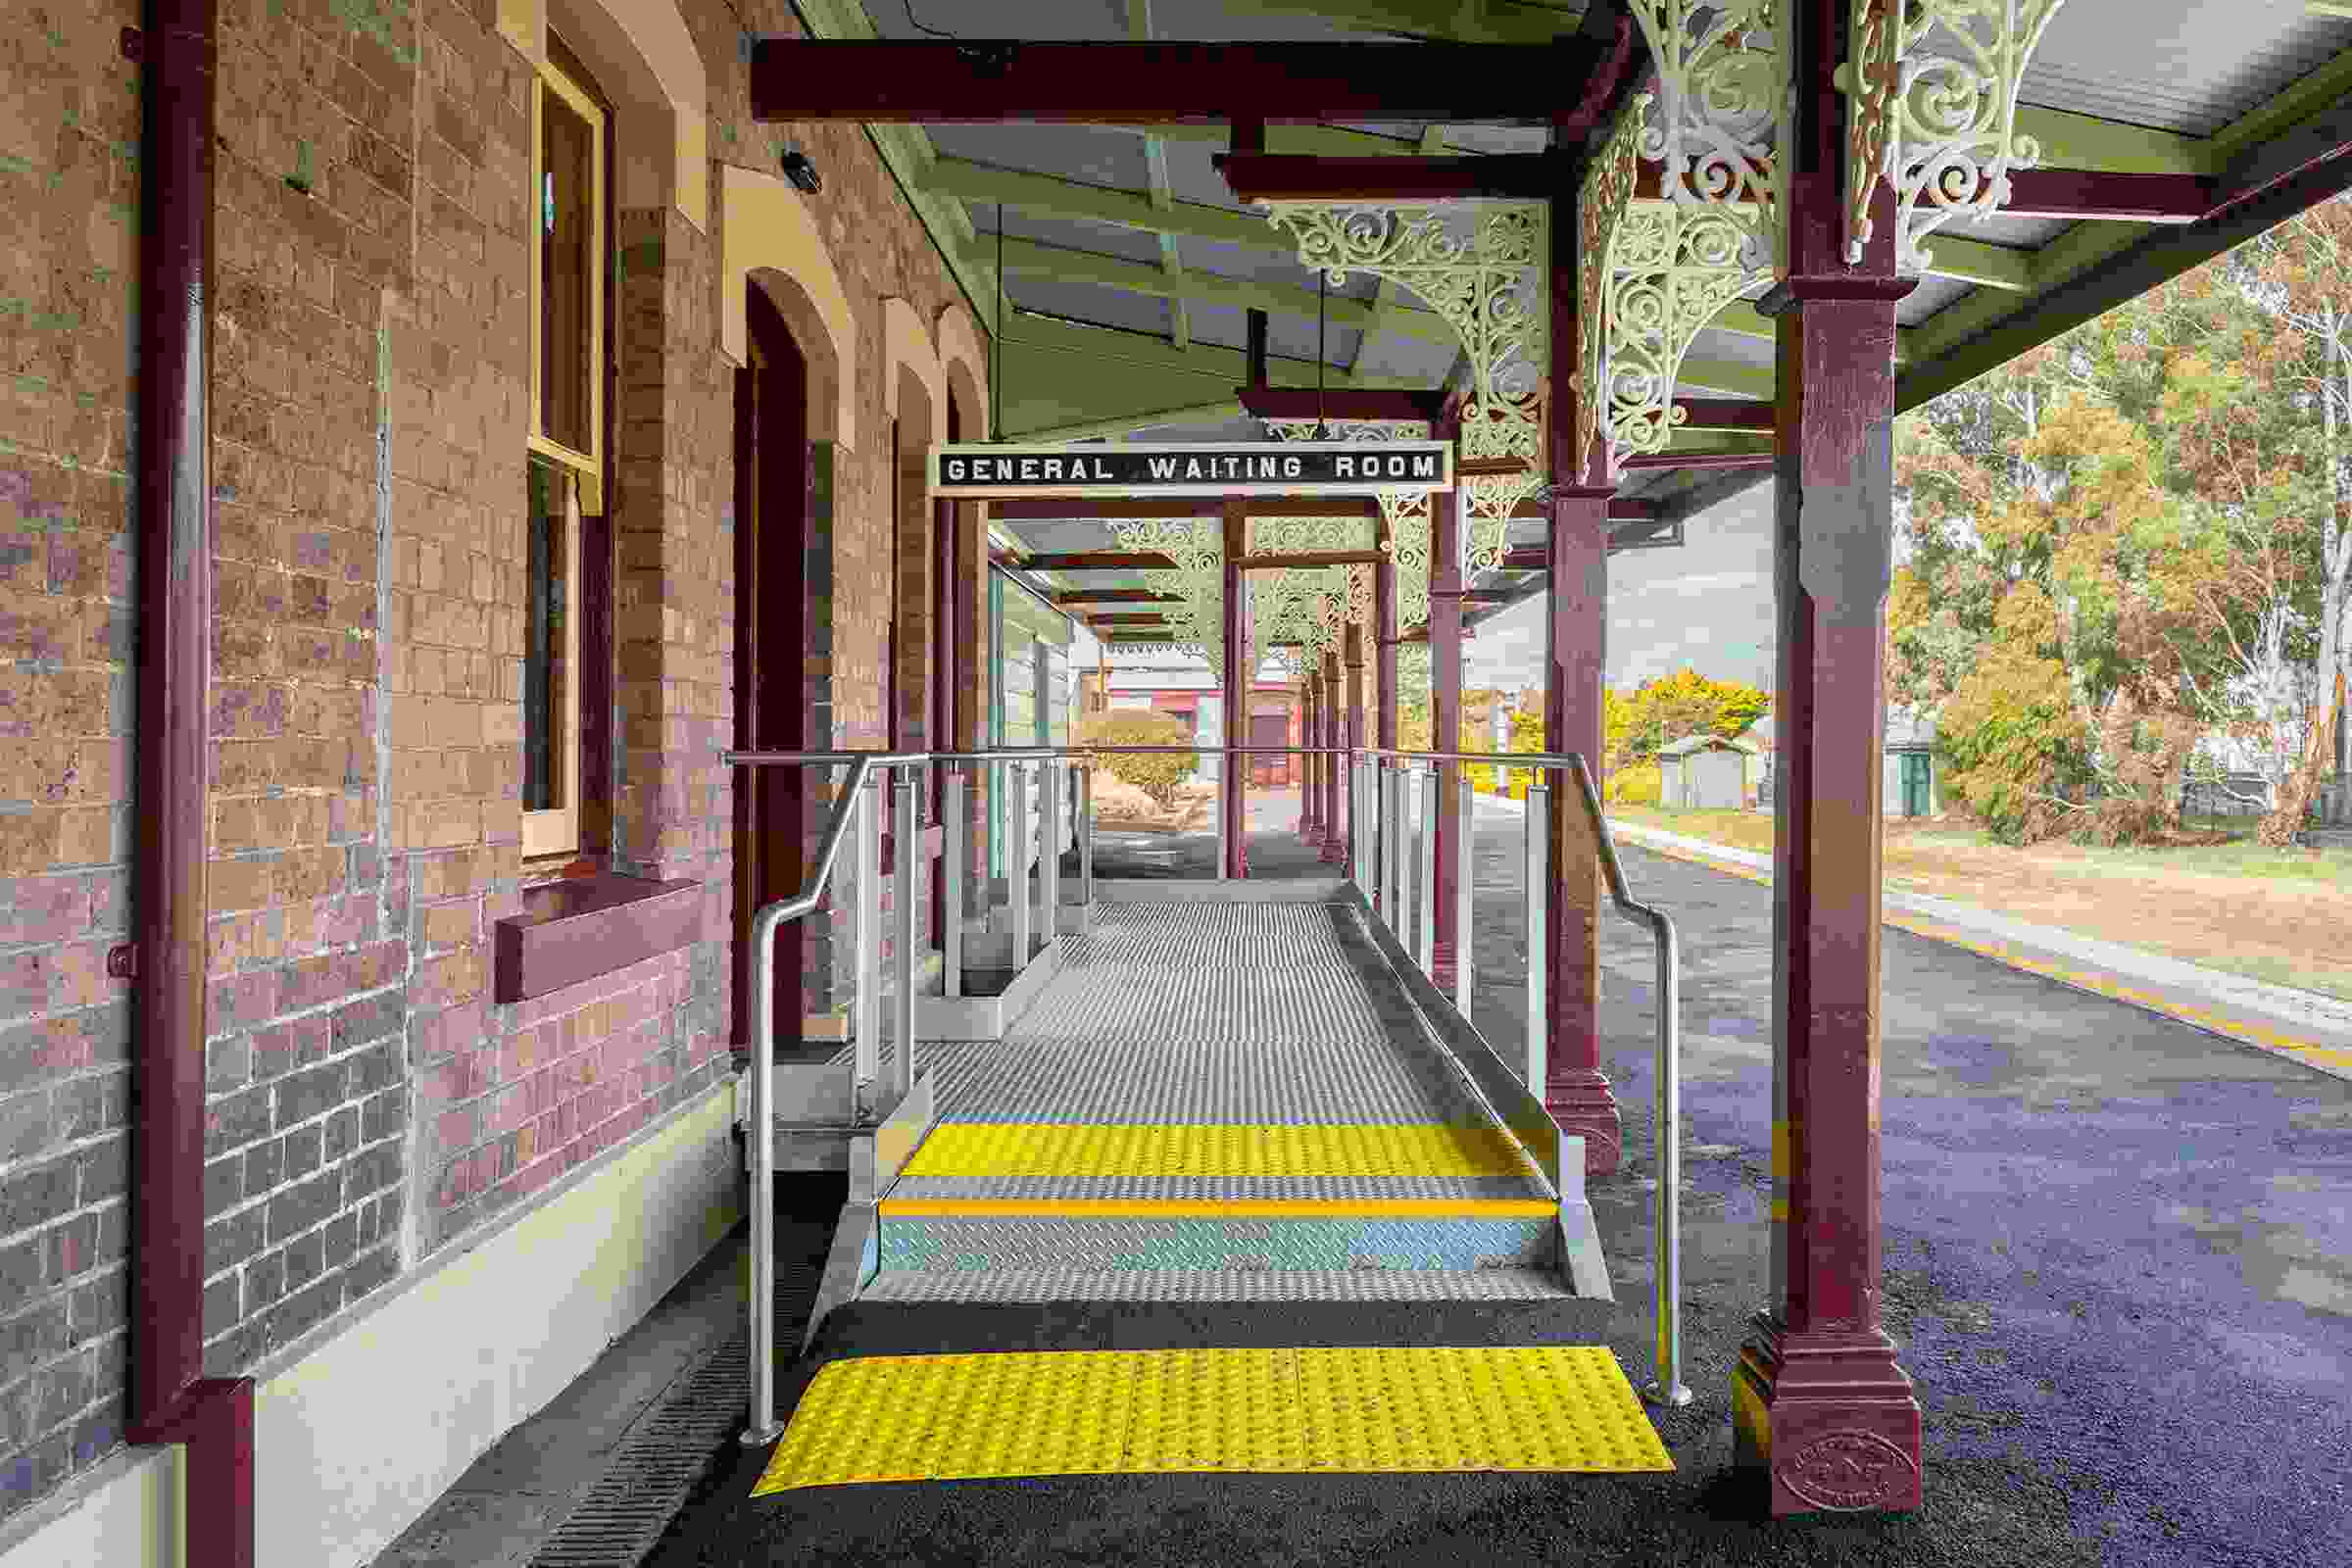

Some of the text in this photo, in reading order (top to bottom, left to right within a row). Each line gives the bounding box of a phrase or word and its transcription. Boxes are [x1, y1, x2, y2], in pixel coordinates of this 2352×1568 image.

[948, 456, 1435, 480] GENERAL WAITING ROOM
